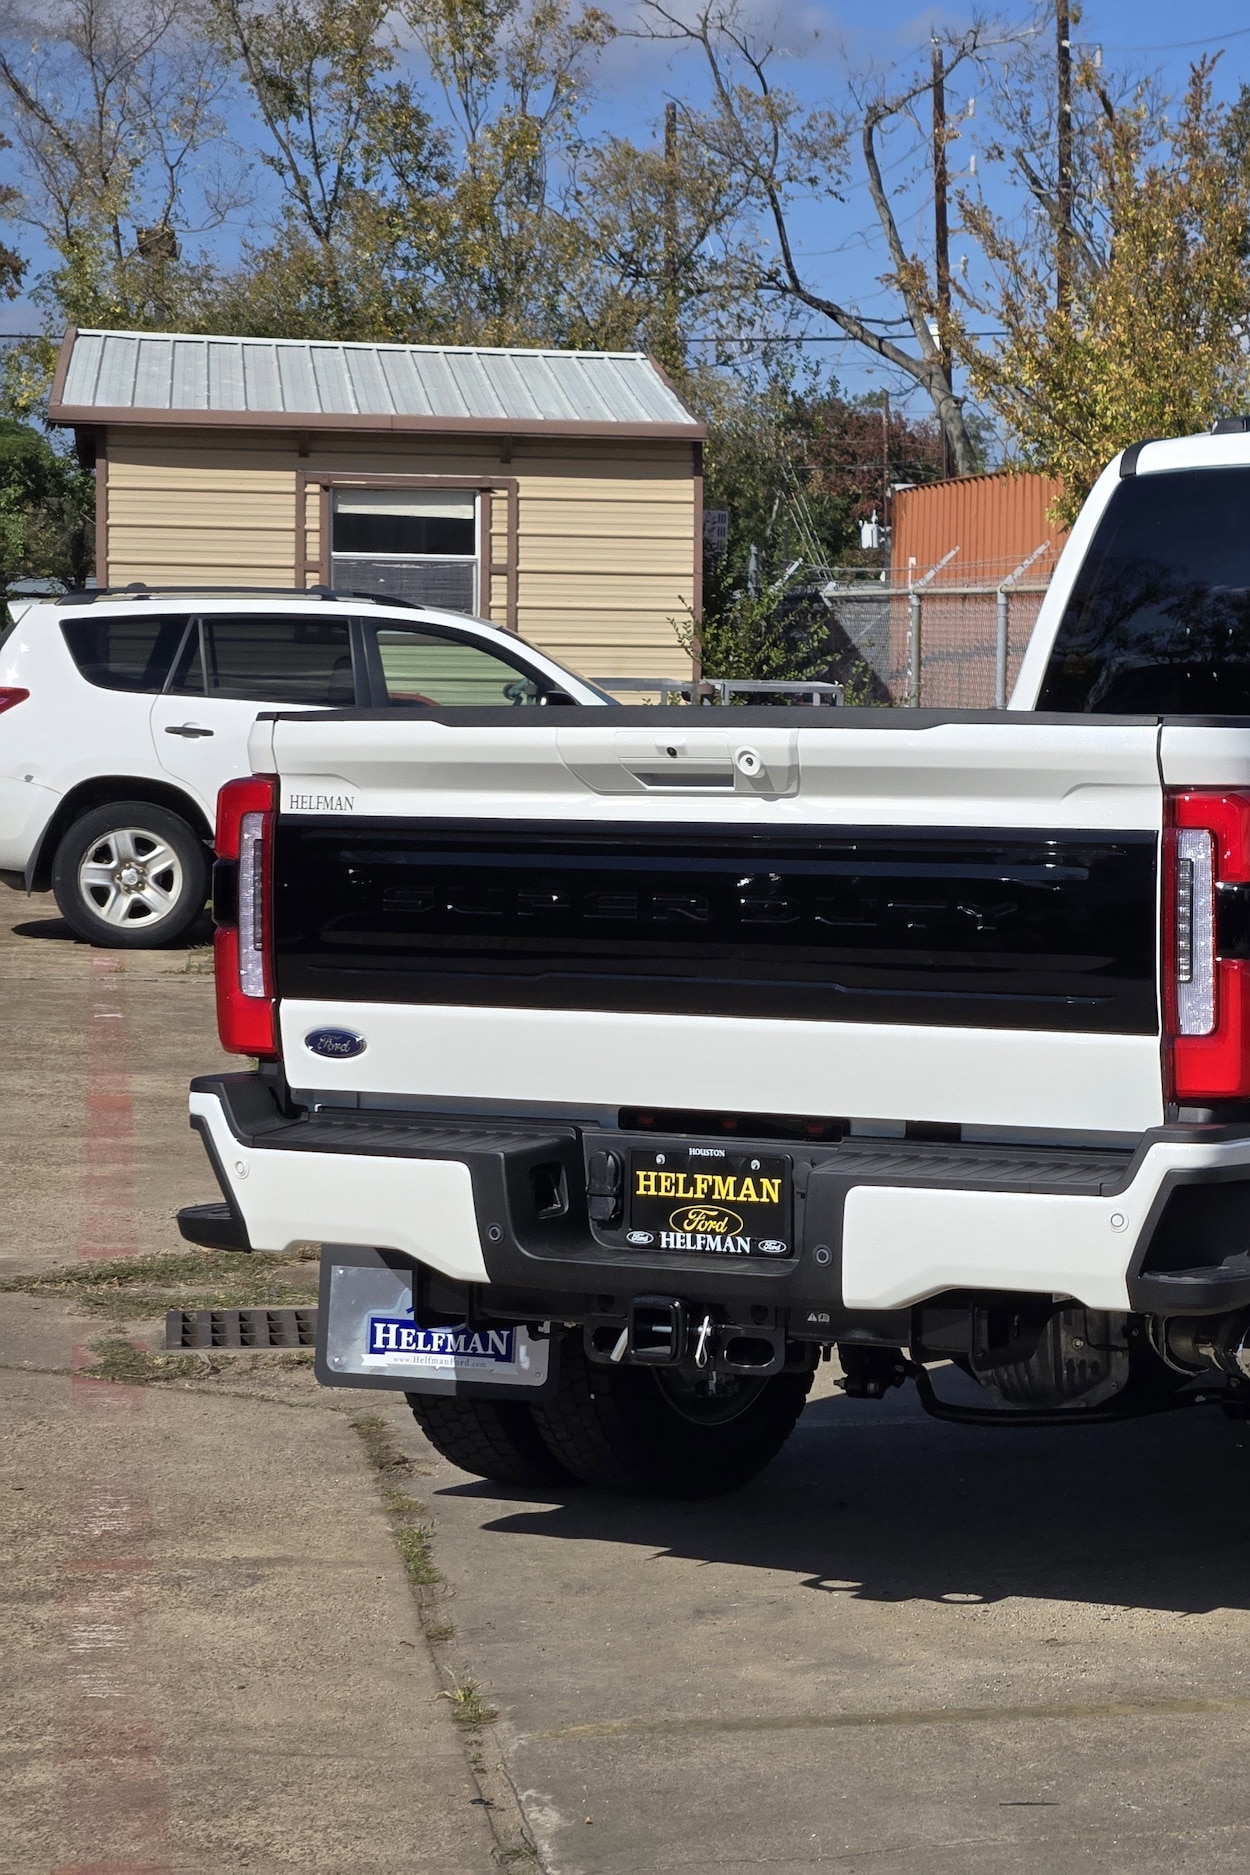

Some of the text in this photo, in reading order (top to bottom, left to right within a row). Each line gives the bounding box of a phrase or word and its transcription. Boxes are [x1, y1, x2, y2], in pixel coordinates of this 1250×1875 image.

[289, 794, 355, 812] HELFMAN
[689, 1147, 726, 1158] HOUSTON
[635, 1170, 782, 1204] HELFMAN
[683, 1208, 729, 1234] Ford
[659, 1231, 752, 1254] HELFMAN
[372, 1322, 511, 1356] HELFMAN
[393, 1355, 487, 1369] www.HelfmanFord.com
